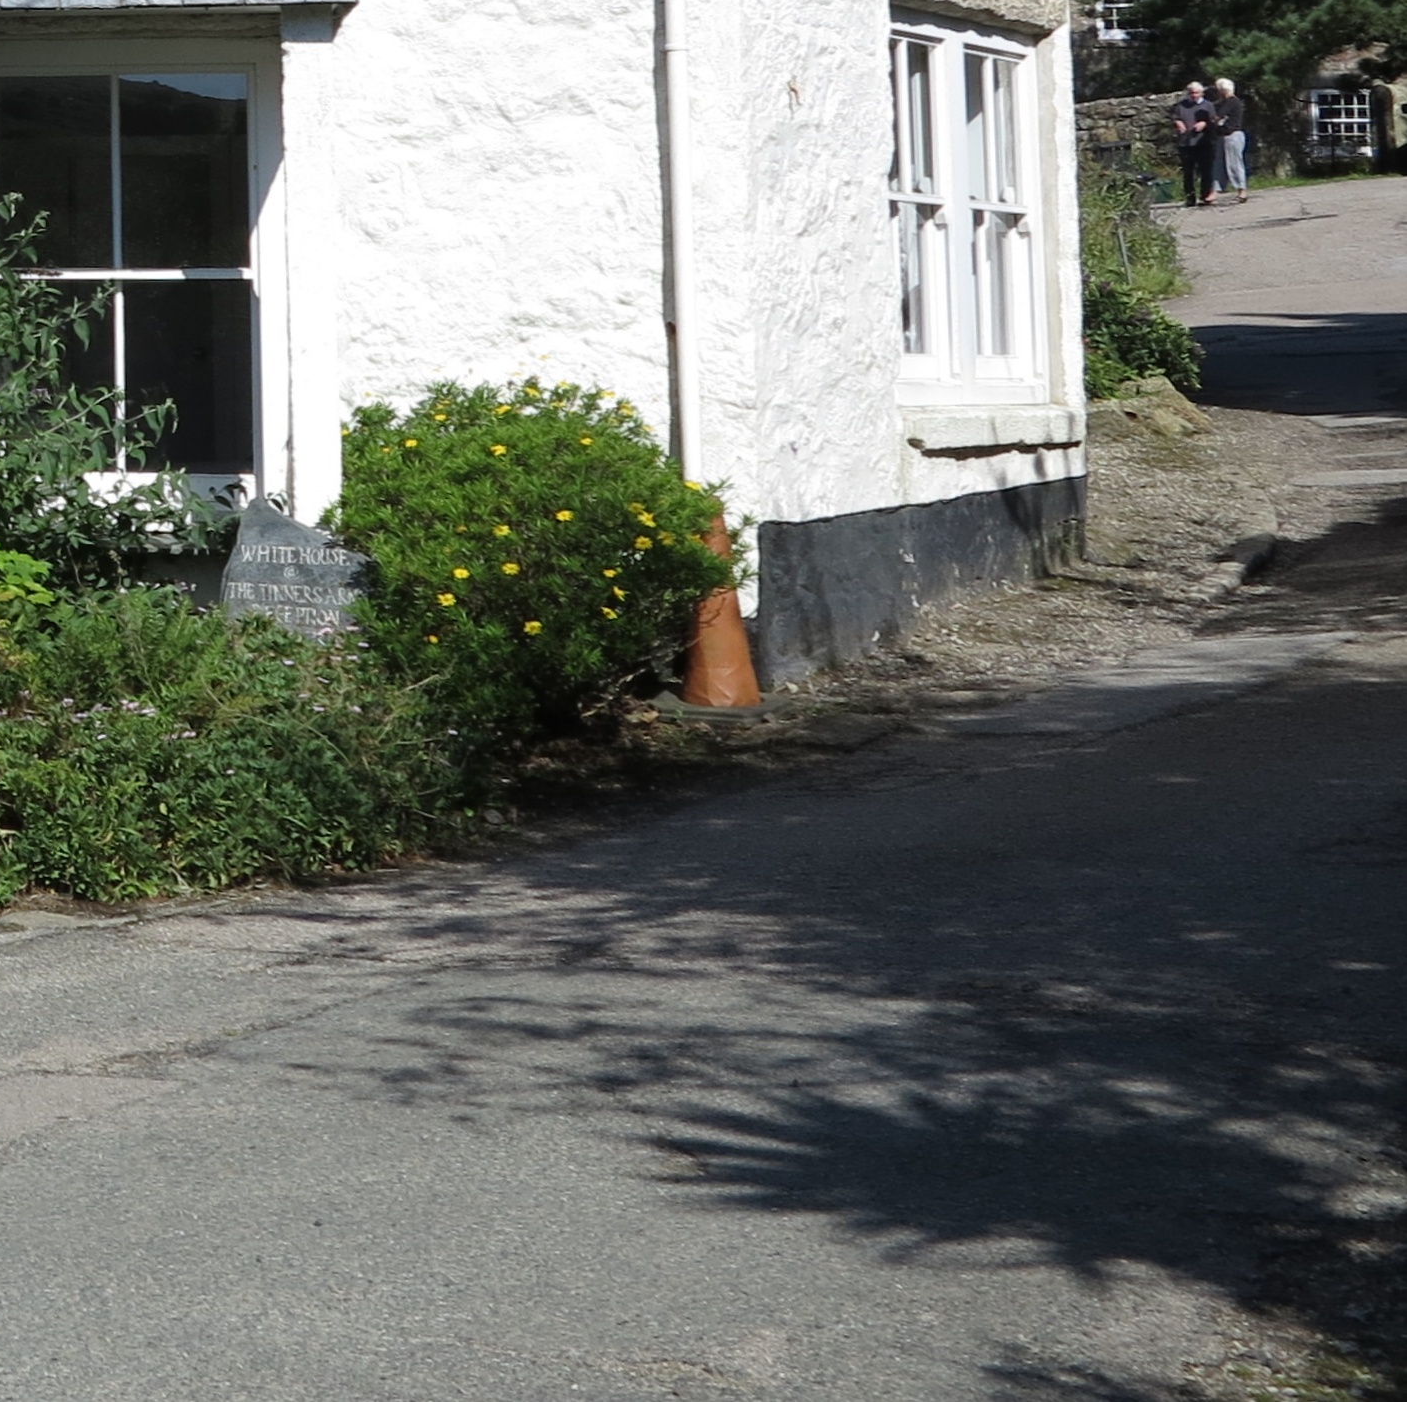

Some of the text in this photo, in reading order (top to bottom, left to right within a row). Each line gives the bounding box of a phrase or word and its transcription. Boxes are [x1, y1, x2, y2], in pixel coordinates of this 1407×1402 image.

[240, 544, 351, 566] WHITE HOUSE
[283, 565, 300, 580] @
[227, 582, 256, 600] THE
[258, 583, 324, 605] TINNERS
